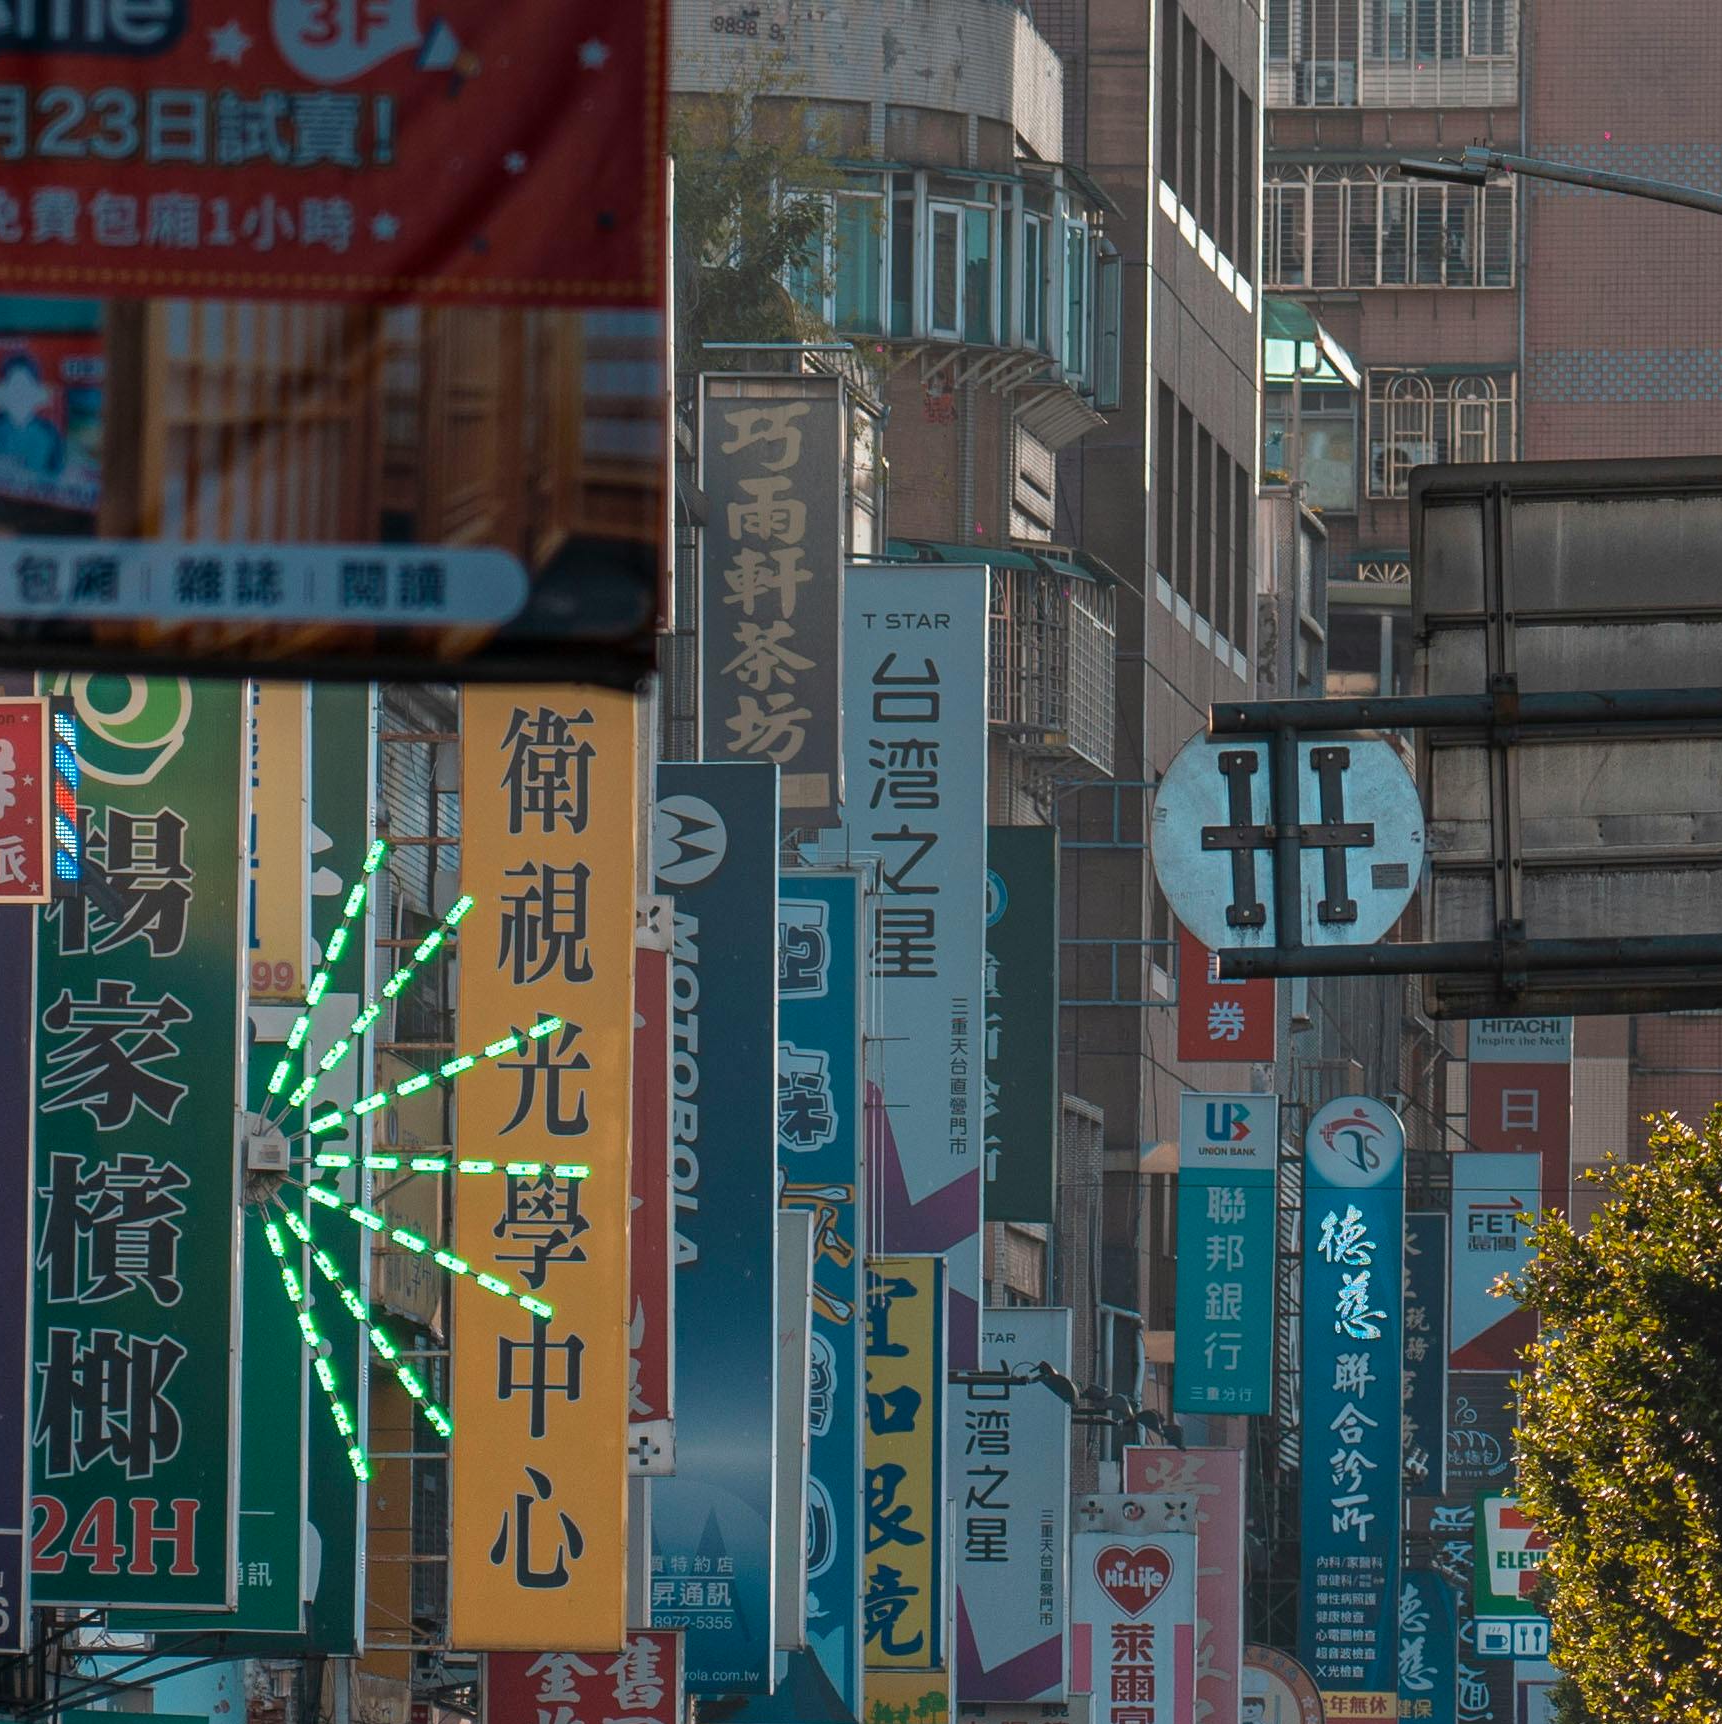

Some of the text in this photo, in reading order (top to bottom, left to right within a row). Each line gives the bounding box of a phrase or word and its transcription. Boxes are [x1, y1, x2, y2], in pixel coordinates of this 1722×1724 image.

[721, 401, 816, 763] 巧雨軒茶坊
[862, 614, 951, 630] T STAR
[1477, 1036, 1513, 1049] Inspire
[1539, 1035, 1566, 1047] Next
[1482, 1019, 1561, 1034] HITACHI
[673, 912, 700, 1266] MOTOROLA
[37, 803, 197, 1482] 楊家檳榔
[1198, 1147, 1256, 1156] UNION BANK
[1205, 1186, 1247, 1372] 聯邦銀行
[29, 1495, 199, 1576] 24H
